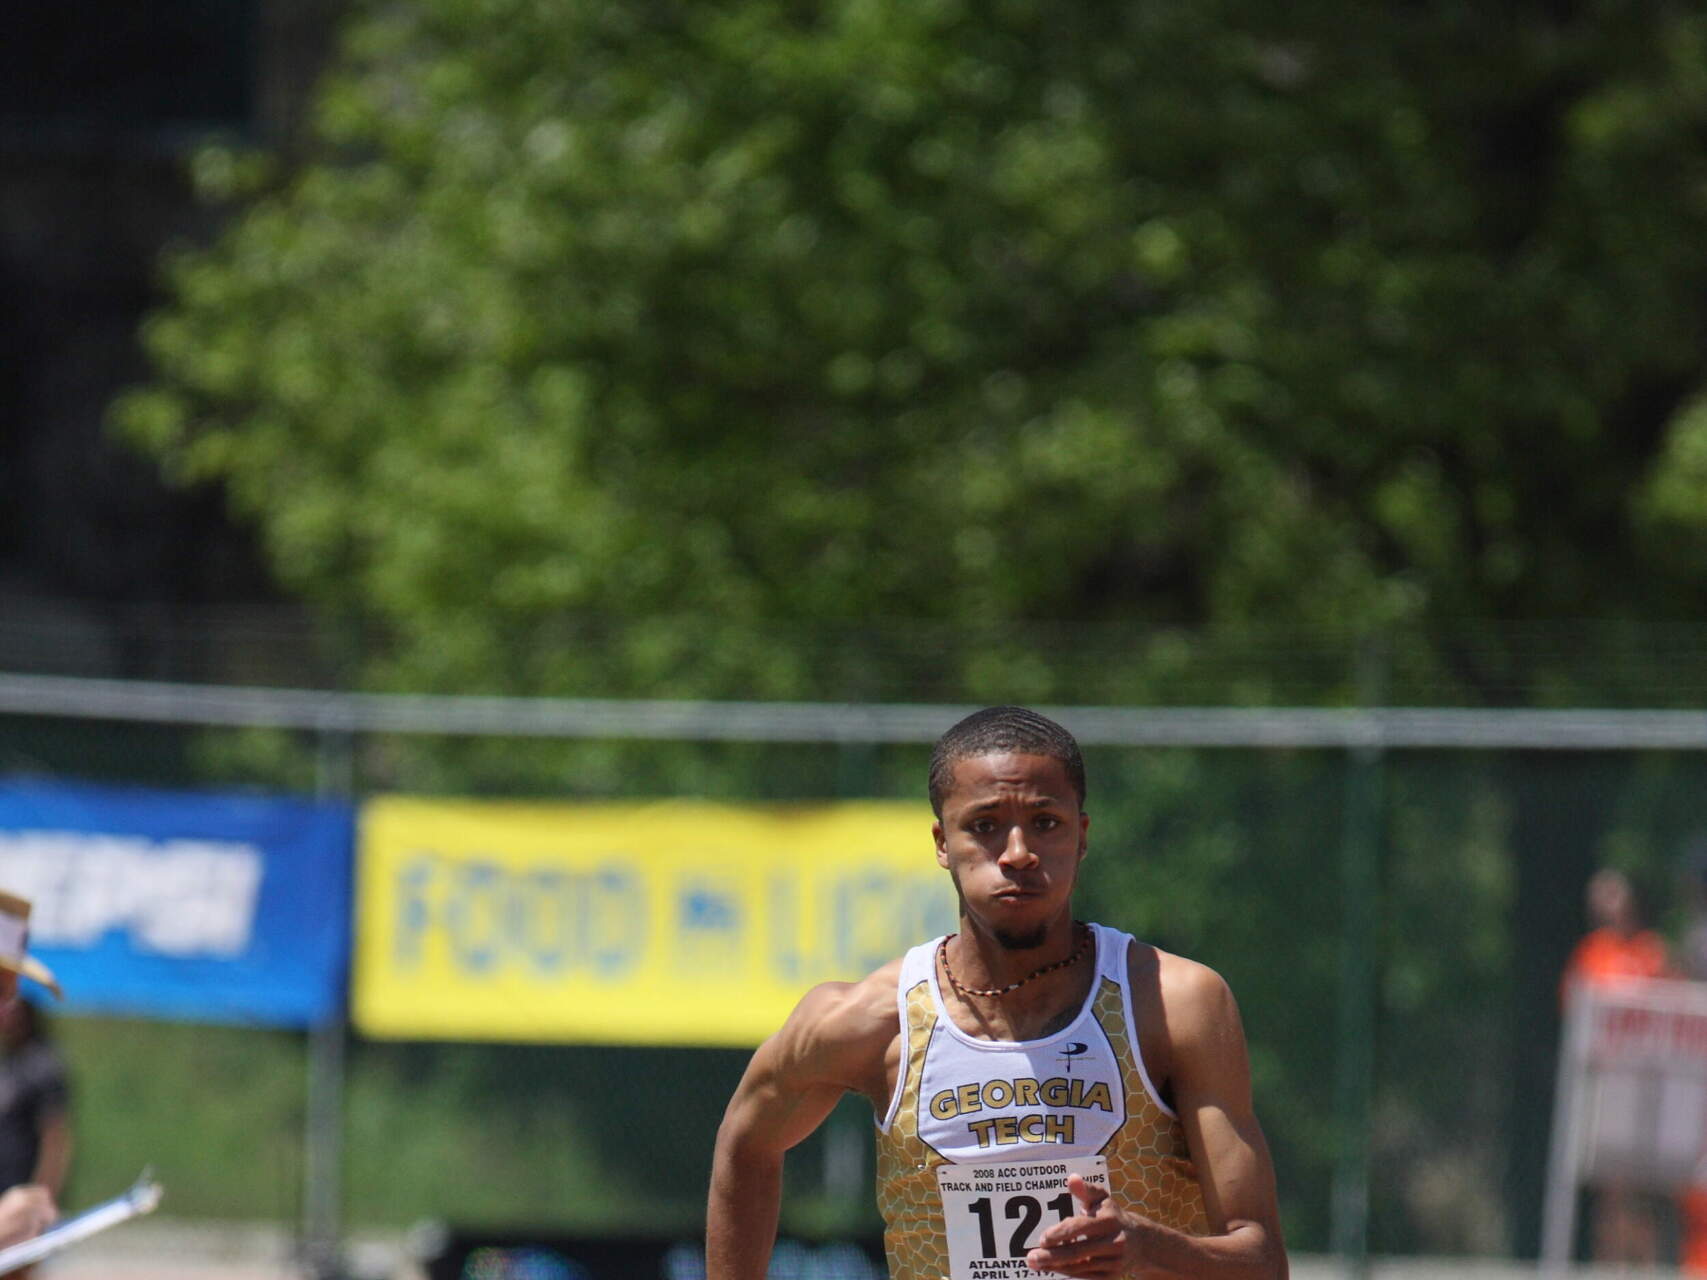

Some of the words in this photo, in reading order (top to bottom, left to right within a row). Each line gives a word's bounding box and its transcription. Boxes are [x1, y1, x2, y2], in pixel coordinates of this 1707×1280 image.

[930, 1077, 1114, 1121] GEORGIA
[969, 1114, 1075, 1148] TECH
[973, 1169, 995, 1179] 2008
[997, 1168, 1017, 1178] ACC
[1020, 1164, 1067, 1177] OUTDOOR
[941, 1182, 972, 1192] TRACK
[975, 1182, 994, 1192] AND
[996, 1180, 1023, 1192] FIELD
[1025, 1174, 1105, 1190] CHAMPIOHIPS
[972, 1270, 1010, 1279] APRIL
